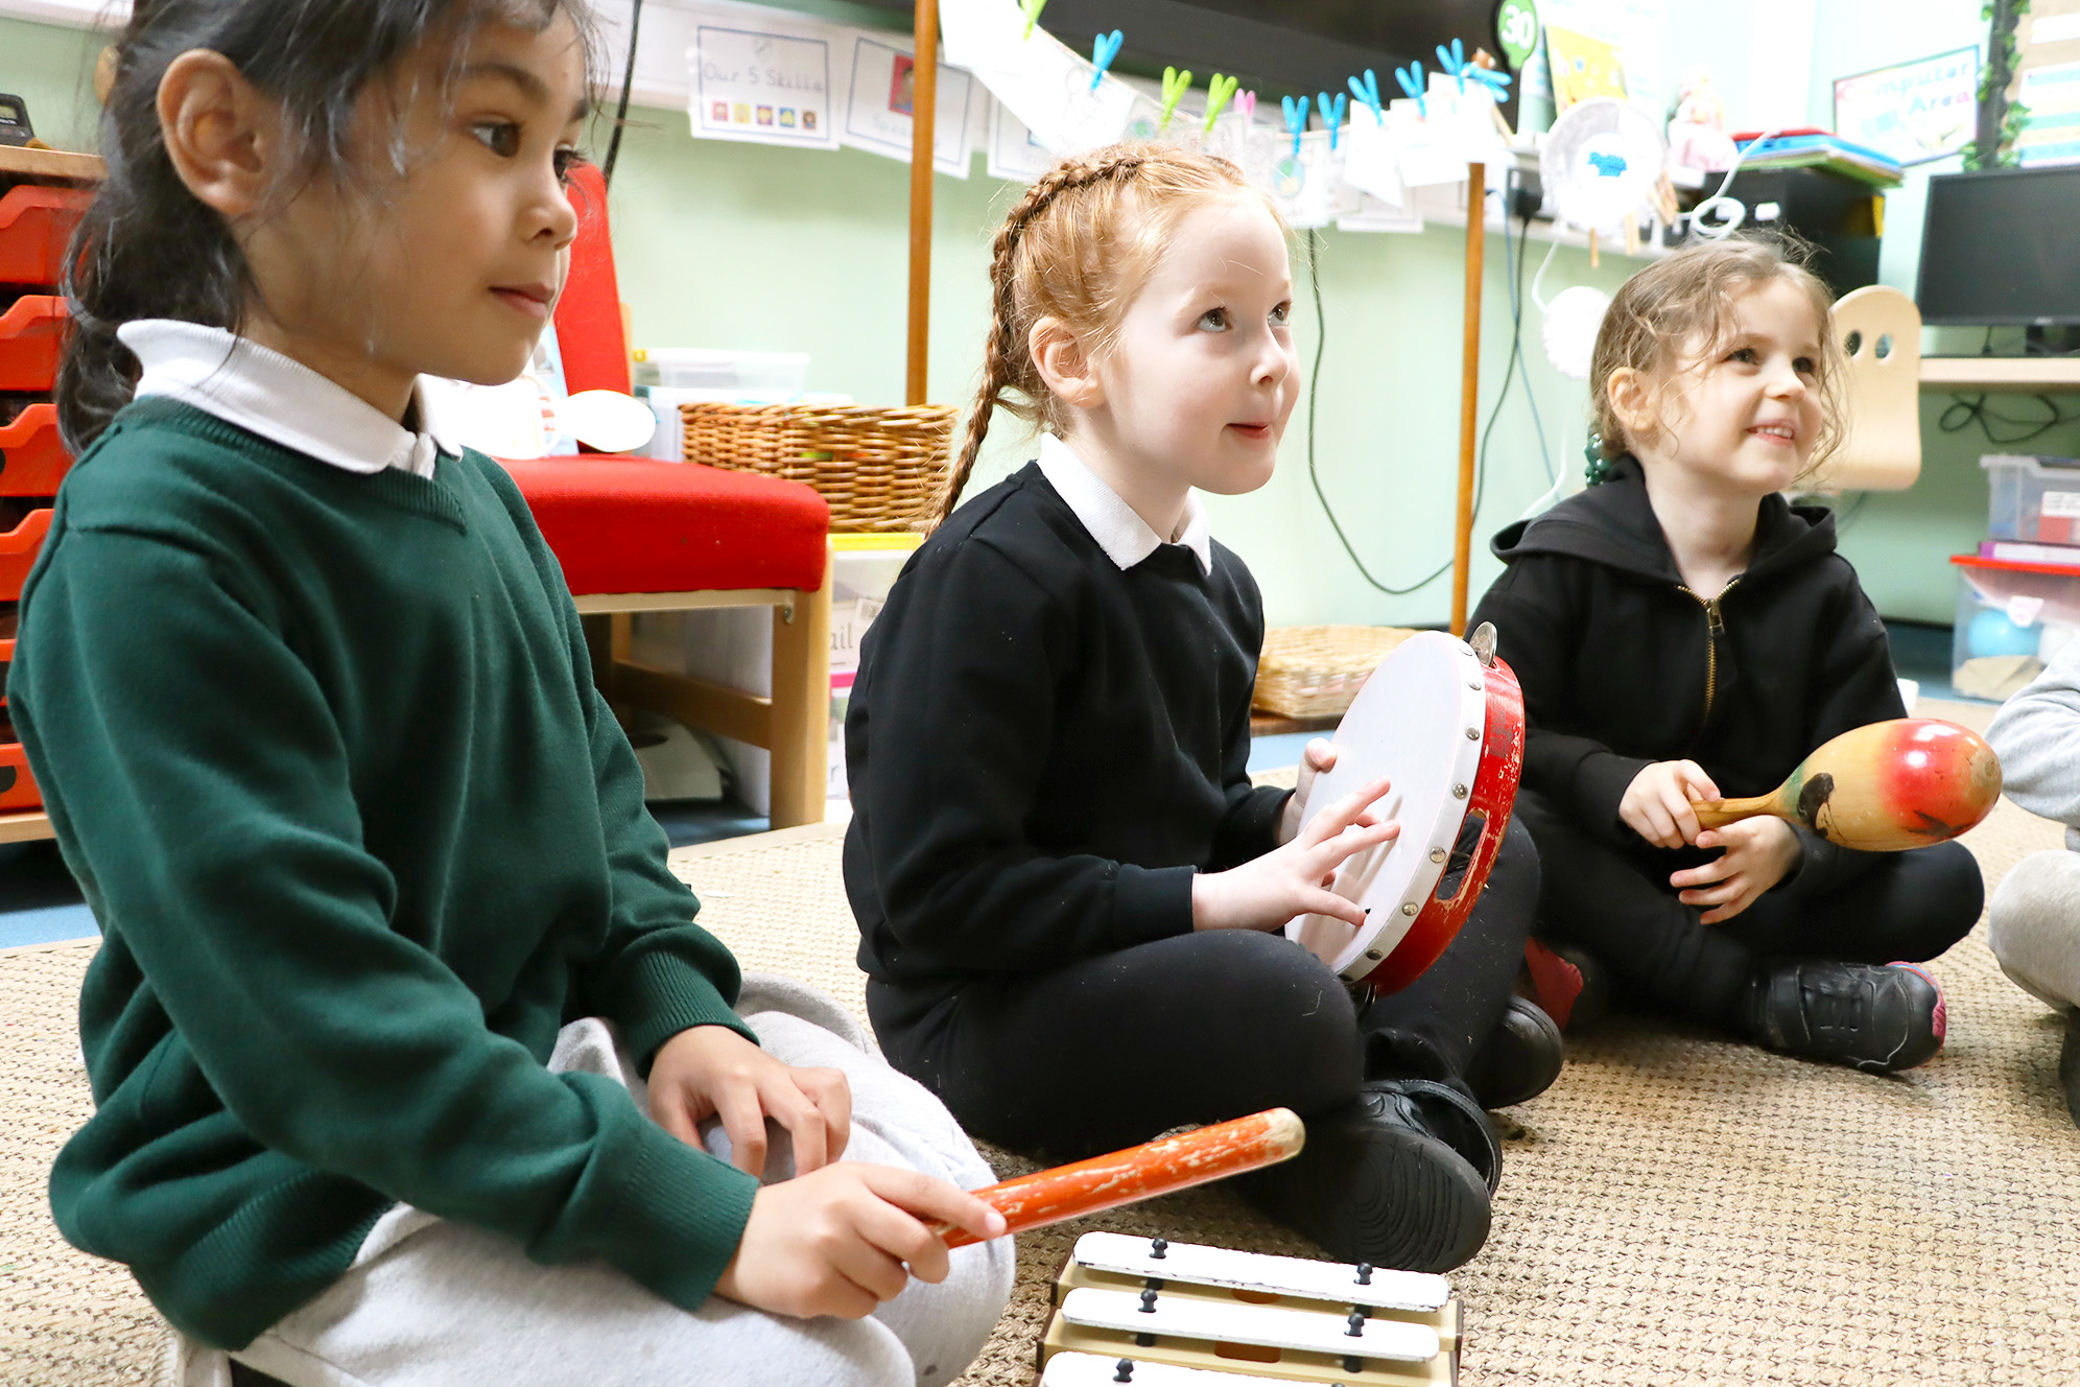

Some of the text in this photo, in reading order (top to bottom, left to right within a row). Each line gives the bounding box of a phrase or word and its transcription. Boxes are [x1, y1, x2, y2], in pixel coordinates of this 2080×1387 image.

[1501, 4, 1535, 49] 30
[703, 62, 824, 92] Our 5 Skills
[1836, 62, 1971, 103] Computer
[1907, 91, 1971, 116] Area
